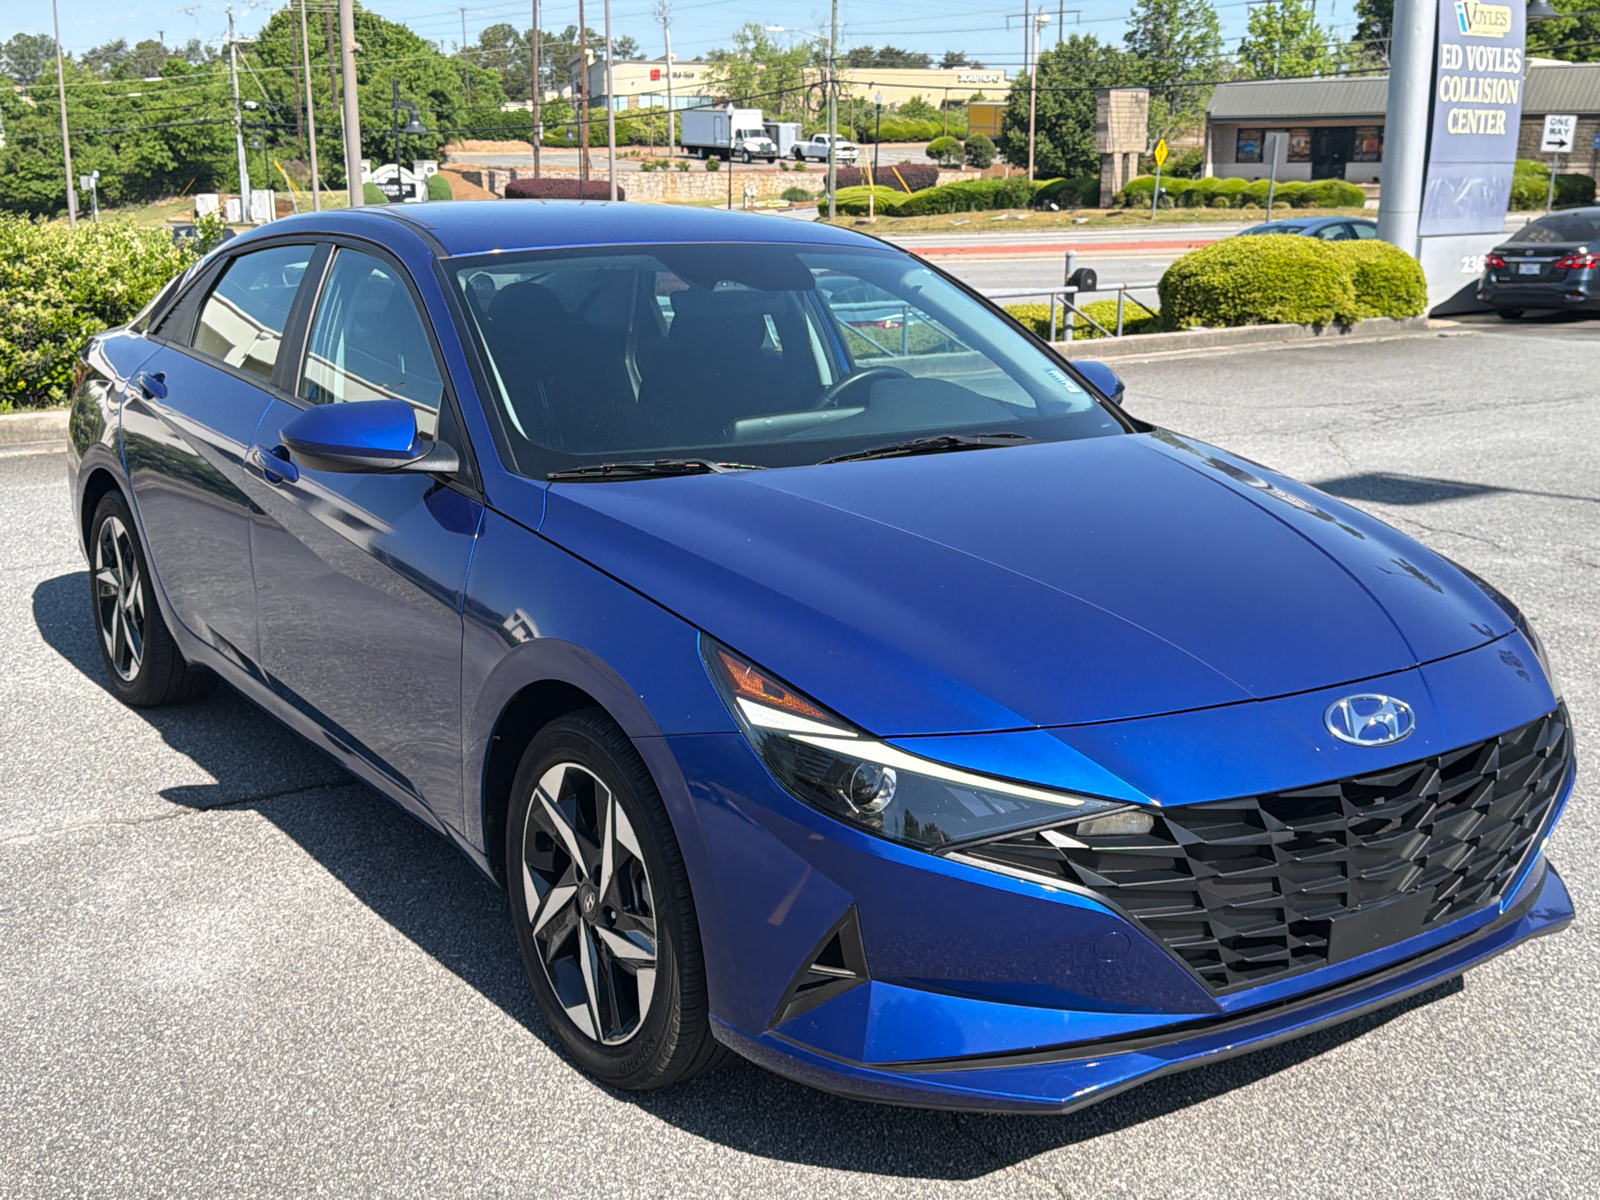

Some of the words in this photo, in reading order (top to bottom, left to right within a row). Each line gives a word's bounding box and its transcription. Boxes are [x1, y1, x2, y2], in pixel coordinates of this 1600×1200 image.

[1441, 44, 1463, 70] ED
[1466, 45, 1522, 74] VOYLES
[1439, 75, 1520, 105] COLLISION
[1447, 108, 1507, 135] CENTER
[1548, 127, 1571, 136] WAY
[1549, 117, 1571, 127] ONE
